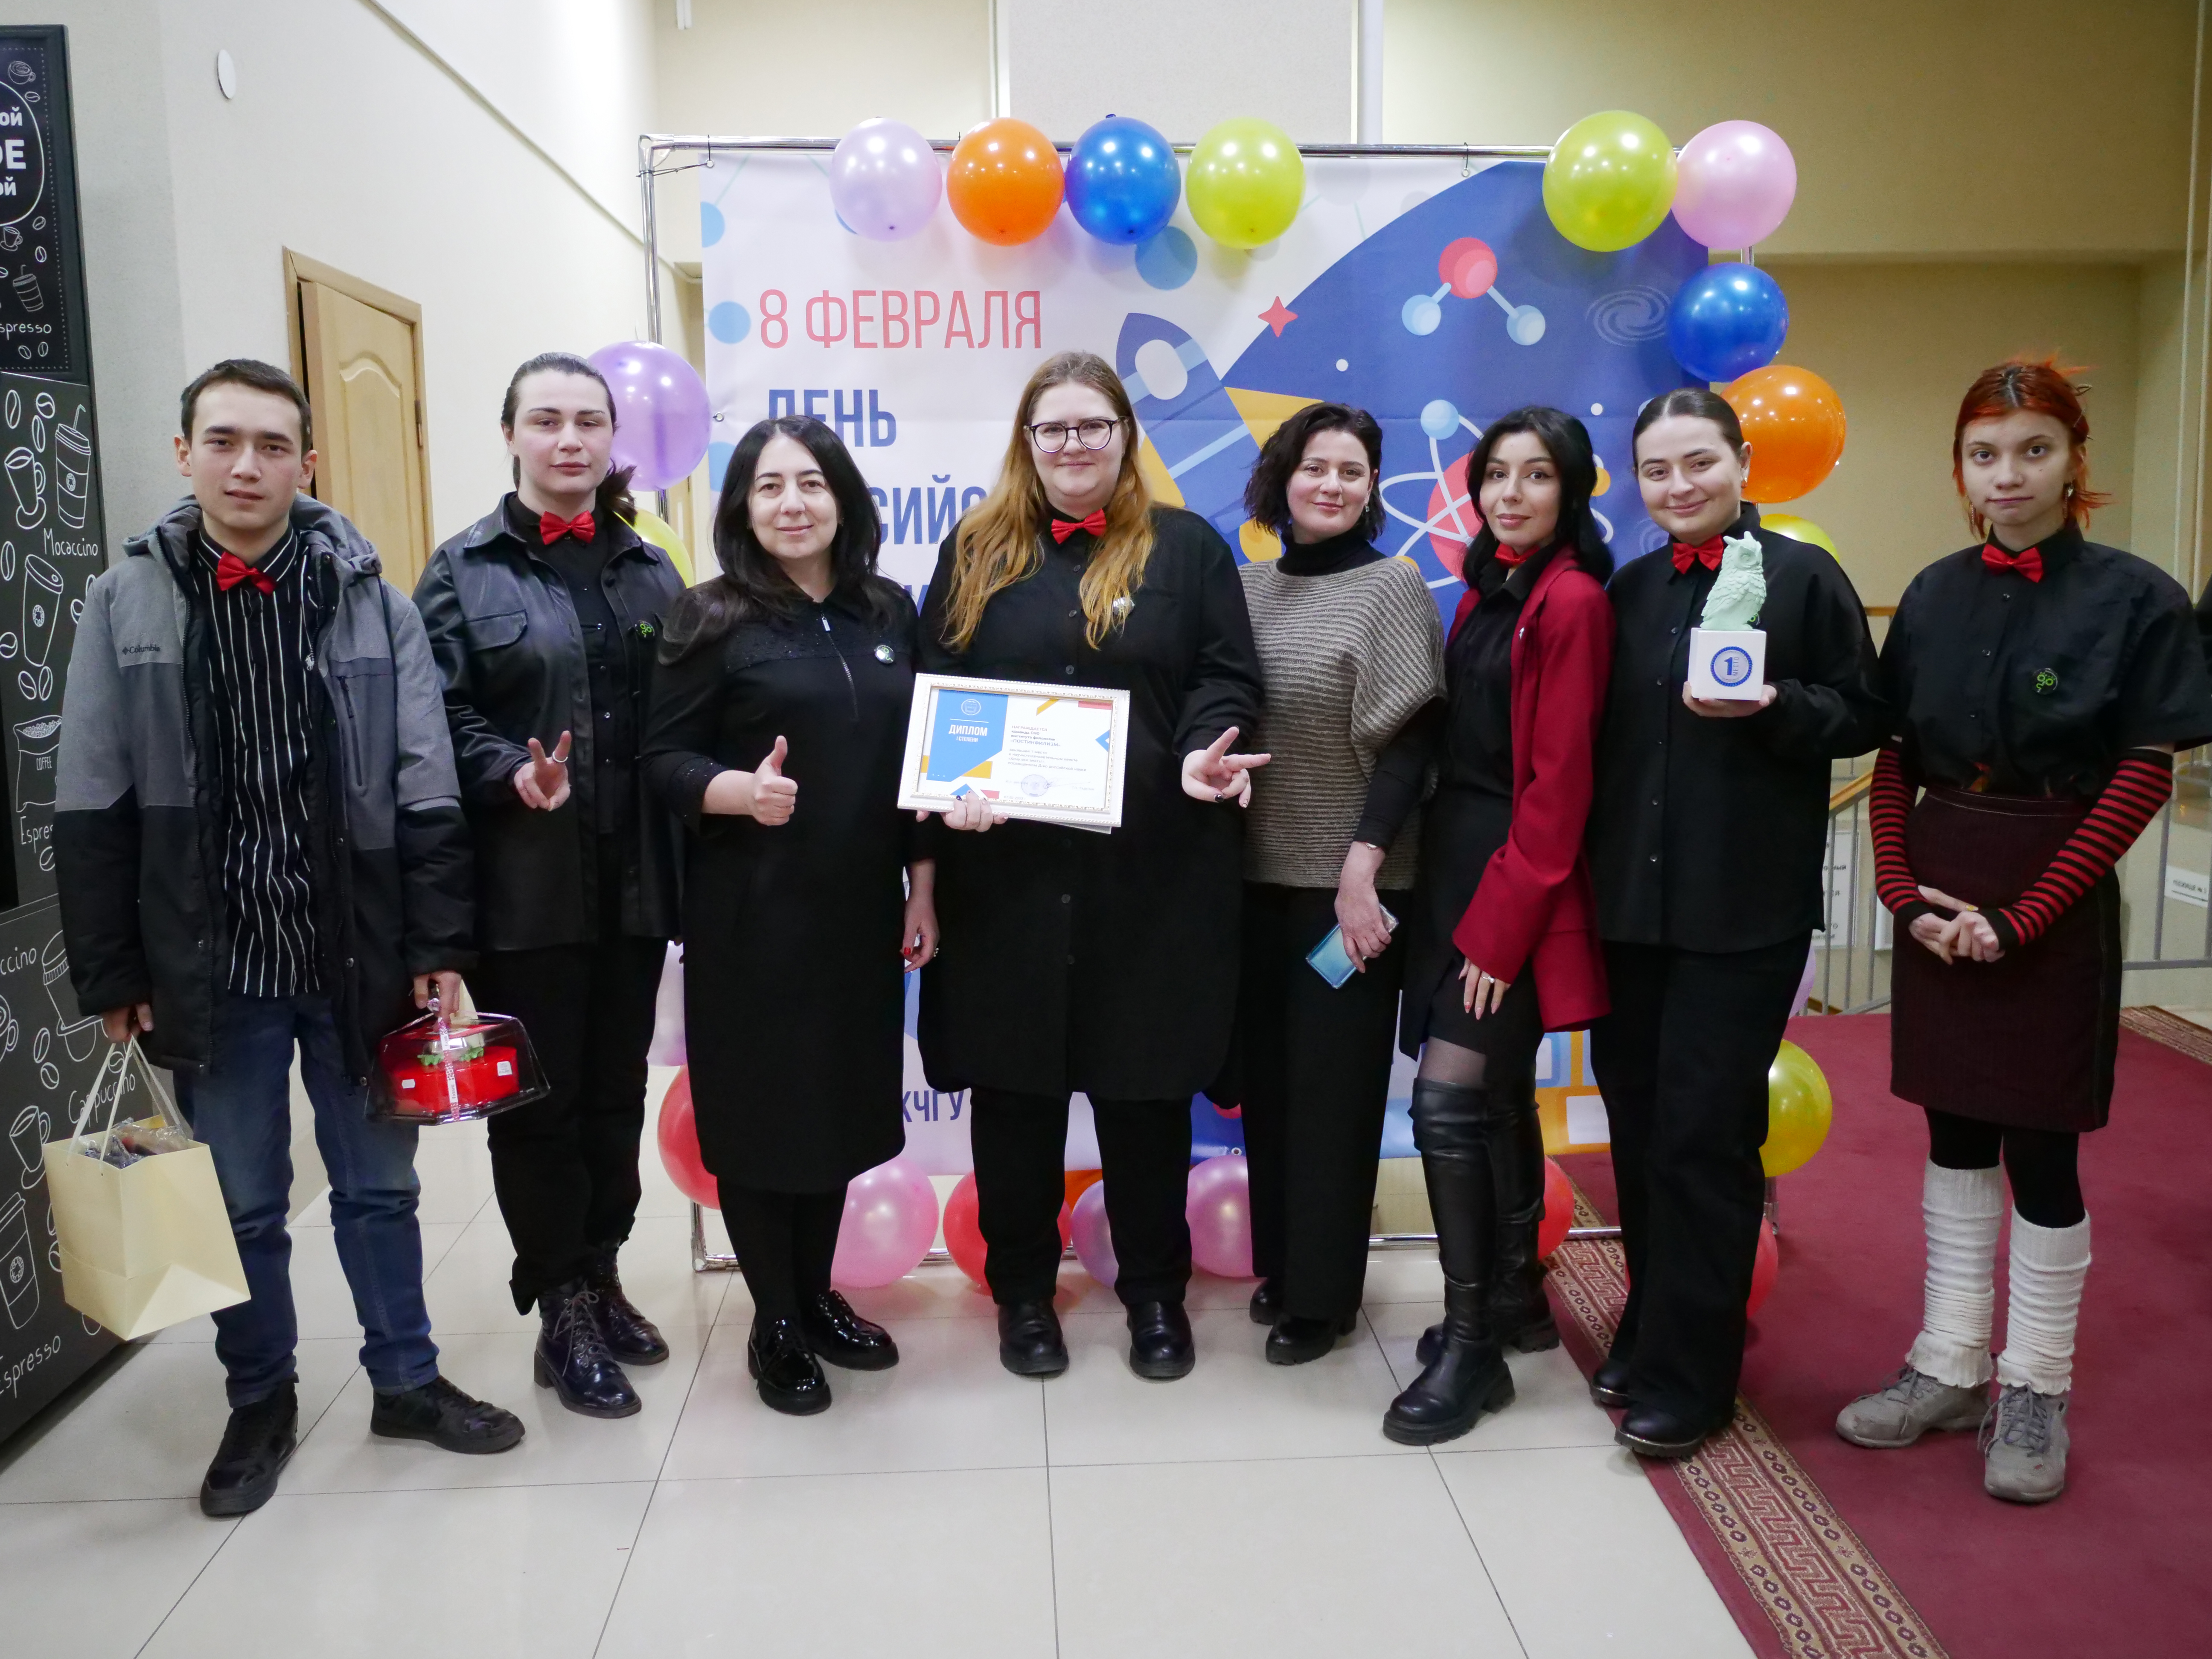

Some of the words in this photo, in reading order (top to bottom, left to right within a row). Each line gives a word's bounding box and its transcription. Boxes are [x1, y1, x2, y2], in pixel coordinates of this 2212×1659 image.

[760, 289, 789, 349] 8
[805, 290, 1042, 349] ФЕВРАЛЯ
[44, 527, 98, 556] Mocaccino
[1724, 657, 1733, 676] 1
[948, 724, 988, 736] ДИПЛОМ
[36, 756, 52, 771] COFFEE
